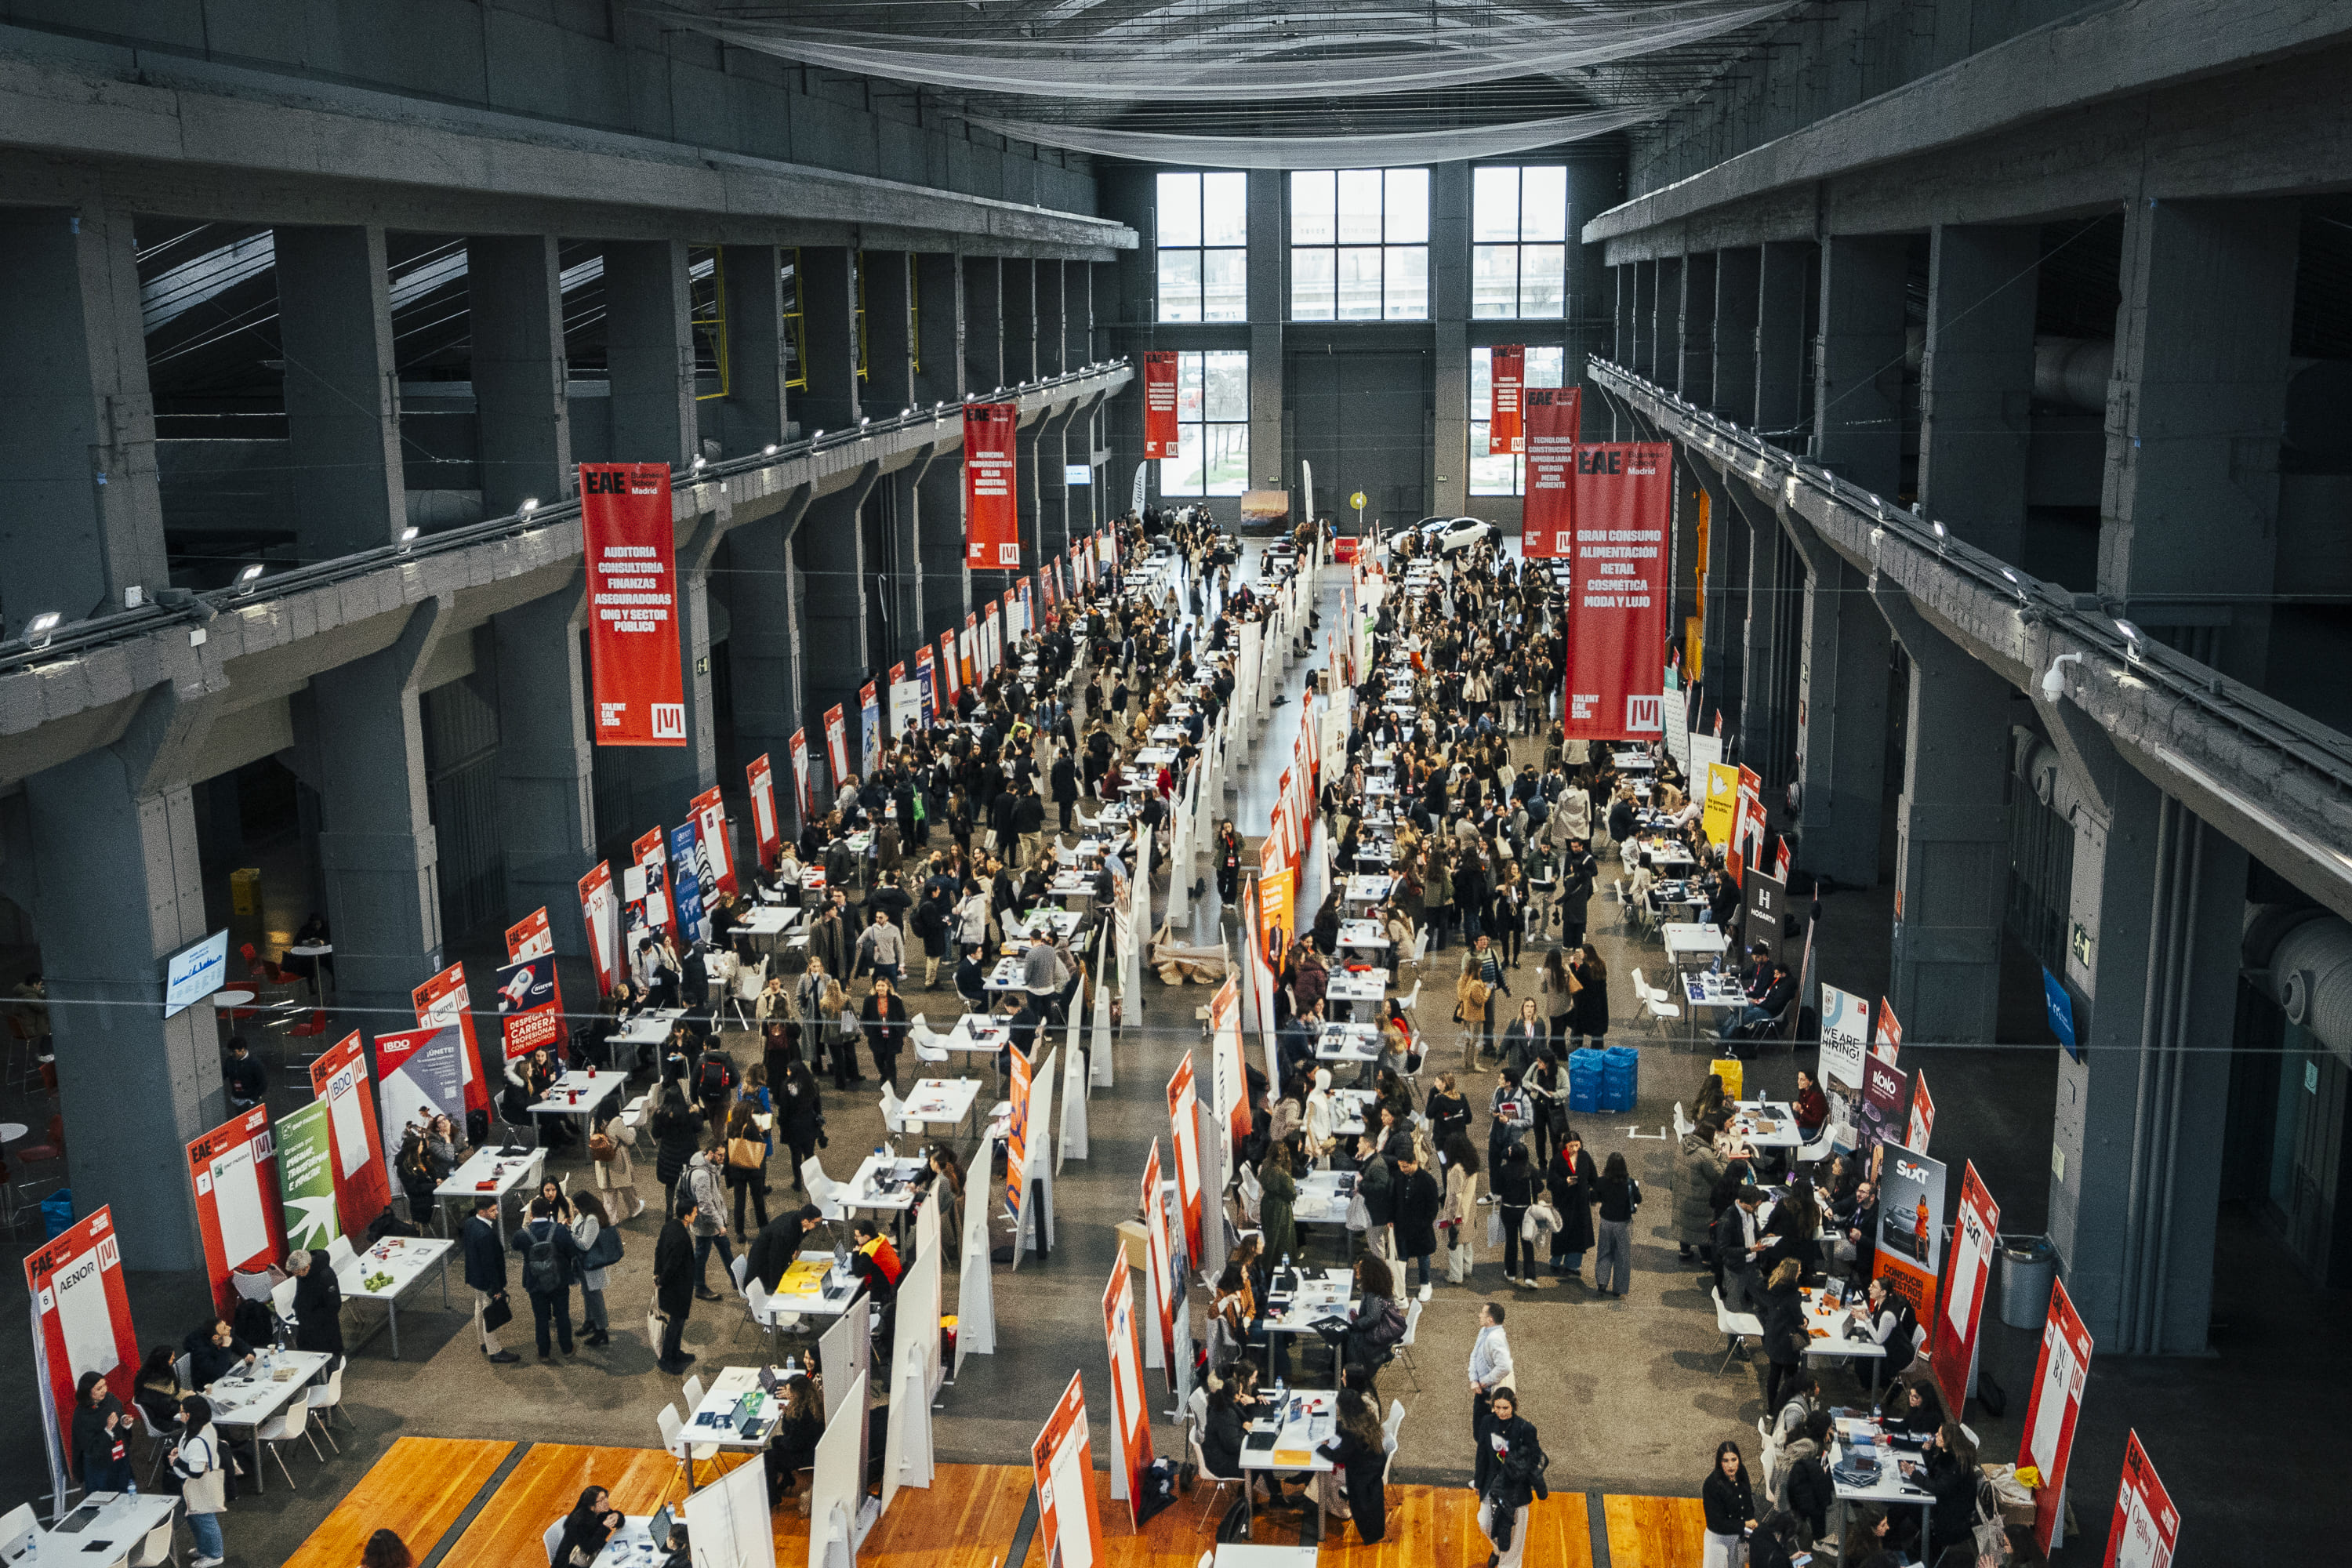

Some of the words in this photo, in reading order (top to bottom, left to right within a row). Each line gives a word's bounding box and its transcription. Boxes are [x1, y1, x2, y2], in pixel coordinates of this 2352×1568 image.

[1528, 392, 1552, 405] EAE
[966, 408, 989, 421] EAE
[1578, 452, 1621, 474] EAE
[586, 472, 626, 494] EAE
[1577, 530, 1607, 542] GRAN
[1608, 530, 1662, 542] CONSUMO
[604, 546, 657, 558] AUDITORÍA
[1580, 546, 1658, 558] ALIMENTACIÓN
[597, 562, 664, 574] CONSULTORÍA
[1600, 563, 1636, 575] RETAIL
[608, 578, 656, 589] FINANZAS
[1587, 579, 1648, 591] COSMÉTICA
[594, 593, 672, 604] ASEGURADORAS
[1584, 596, 1615, 608] MODA
[1617, 596, 1624, 608] Y
[1625, 596, 1650, 608] LUJO
[600, 609, 621, 620] ONG
[622, 609, 629, 620] Y
[630, 609, 668, 620] SECTOR
[601, 702, 626, 711] TALENT
[1572, 694, 1599, 702] TALENT
[1571, 710, 1592, 719] 2025
[1759, 888, 1770, 909] H
[1751, 908, 1776, 925] HOGARTH
[510, 1011, 543, 1030] DESPEGA
[546, 1007, 555, 1015] TU
[510, 1015, 556, 1039] CARRERA
[510, 1043, 524, 1053] CON
[525, 1032, 555, 1047] NOSOTROS
[511, 1025, 556, 1046] PROFESIONAL
[1823, 1024, 1838, 1040] WE
[1839, 1033, 1860, 1050] ARE
[386, 1039, 410, 1051] BDO
[1822, 1036, 1860, 1061] HIRING!
[314, 1062, 328, 1083] EAE
[332, 1072, 351, 1095] BDO
[1872, 1070, 1896, 1094] IKONO
[191, 1140, 212, 1164] EAE
[201, 1178, 205, 1188] 7
[31, 1250, 54, 1279] EAE
[60, 1261, 94, 1294] AENOR
[1883, 1263, 1924, 1291] CONDUCIR
[43, 1295, 49, 1305] 6
[2128, 1441, 2142, 1479] EAE
[2132, 1504, 2152, 1555] Ogilvy
